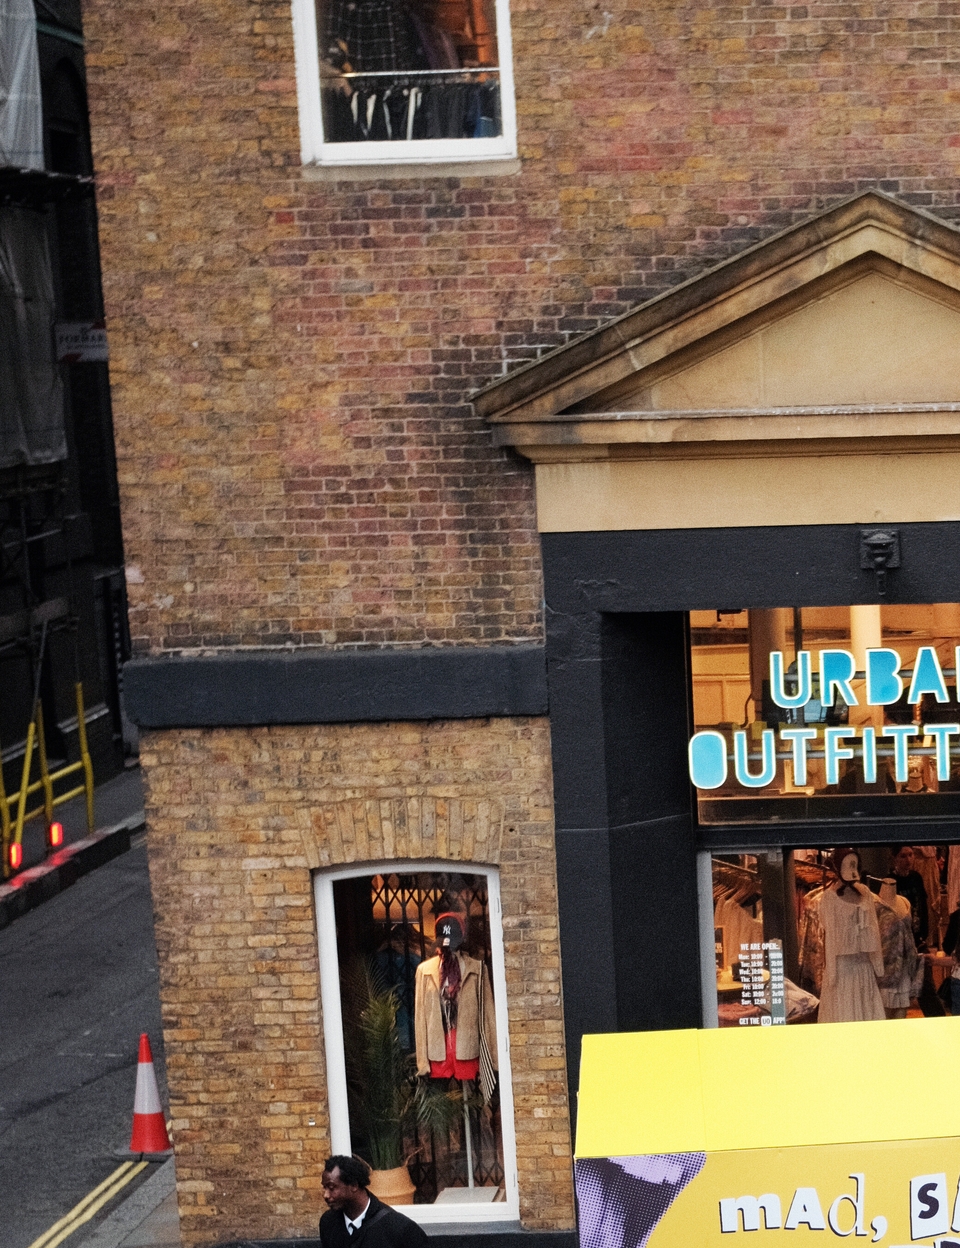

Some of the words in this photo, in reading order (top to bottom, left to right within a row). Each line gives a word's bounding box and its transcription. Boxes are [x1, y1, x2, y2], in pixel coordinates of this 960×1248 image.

[750, 942, 761, 950] ARE
[739, 1017, 749, 1025] GET
[750, 1017, 760, 1025] THE
